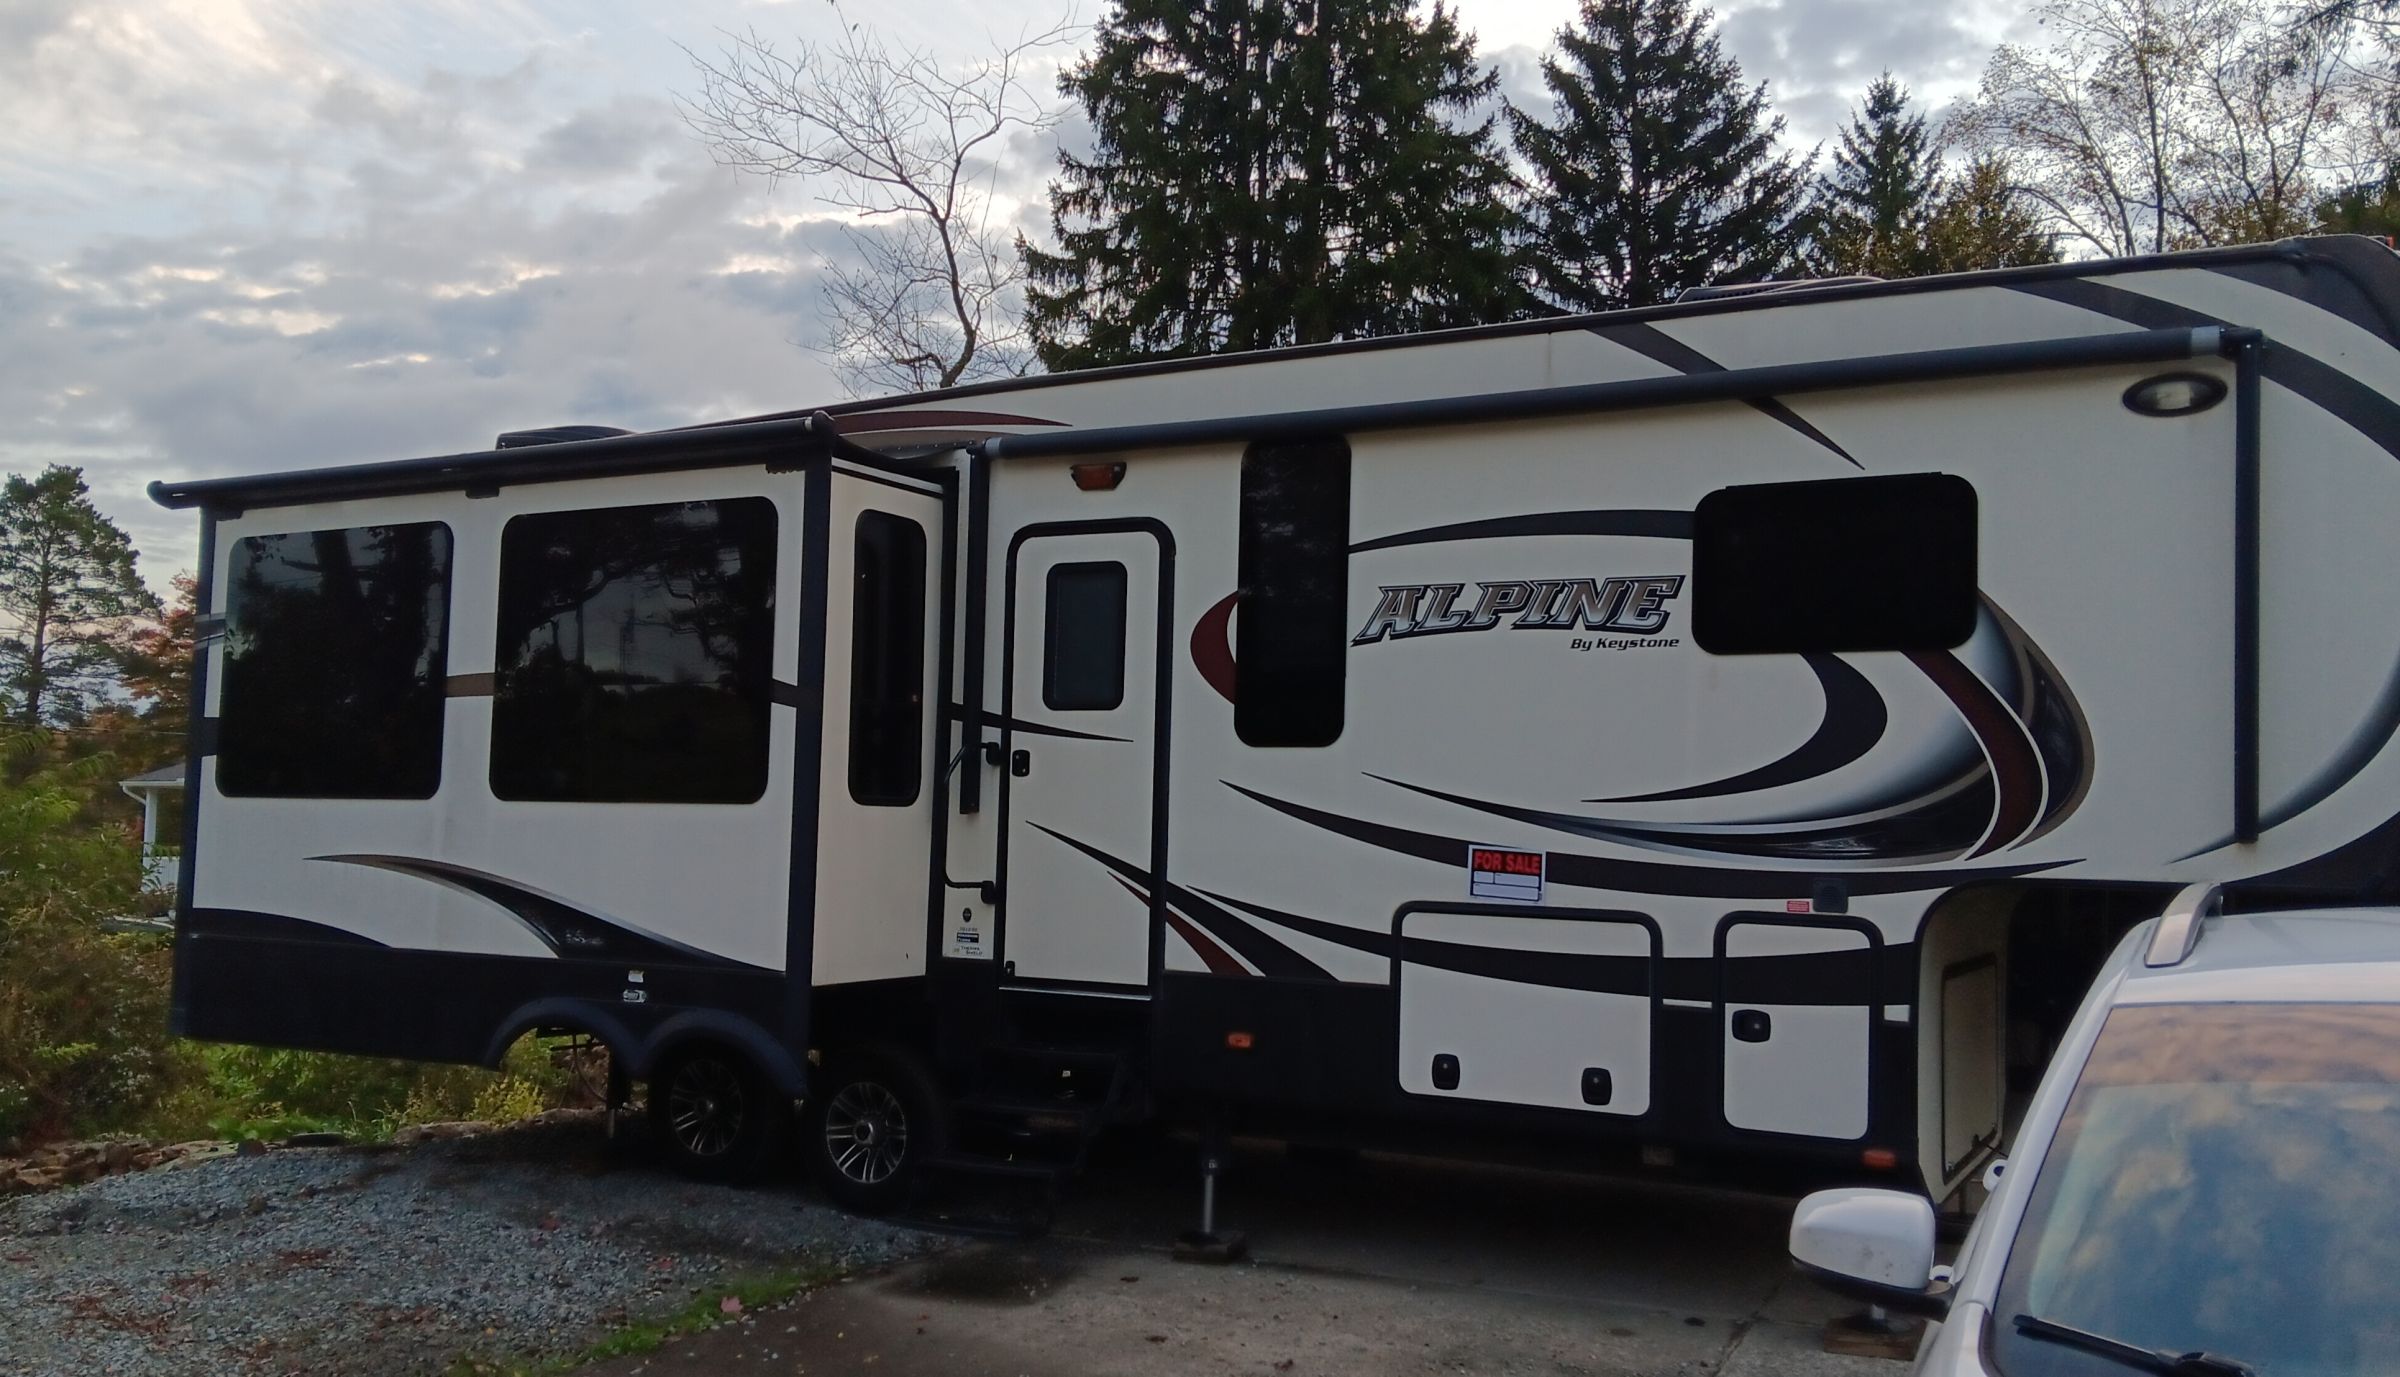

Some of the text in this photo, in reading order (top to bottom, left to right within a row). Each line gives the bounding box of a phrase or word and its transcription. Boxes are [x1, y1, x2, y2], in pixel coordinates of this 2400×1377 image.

[1350, 575, 1686, 647] ALPINE
[1570, 638, 1680, 651] By Keystone
[1474, 850, 1541, 875] FOR SALE
